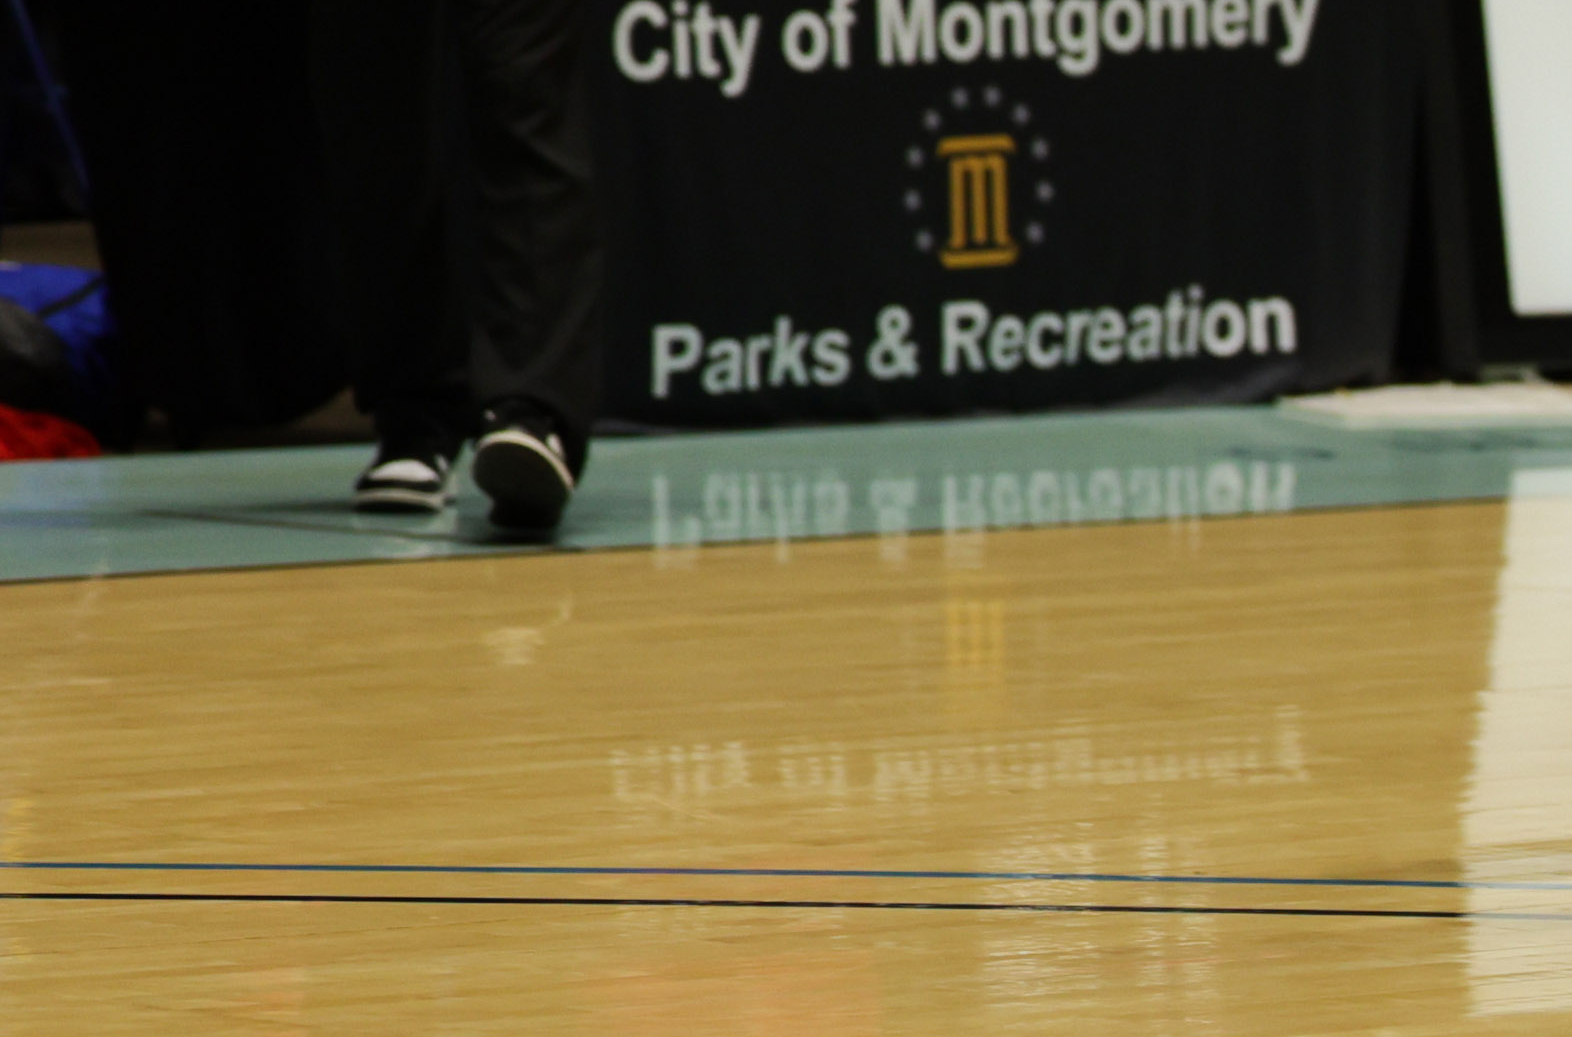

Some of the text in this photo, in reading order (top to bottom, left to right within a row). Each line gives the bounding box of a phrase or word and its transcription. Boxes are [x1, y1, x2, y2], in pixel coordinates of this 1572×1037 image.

[613, 0, 760, 98] City
[652, 285, 1298, 399] Parks & Recreation
